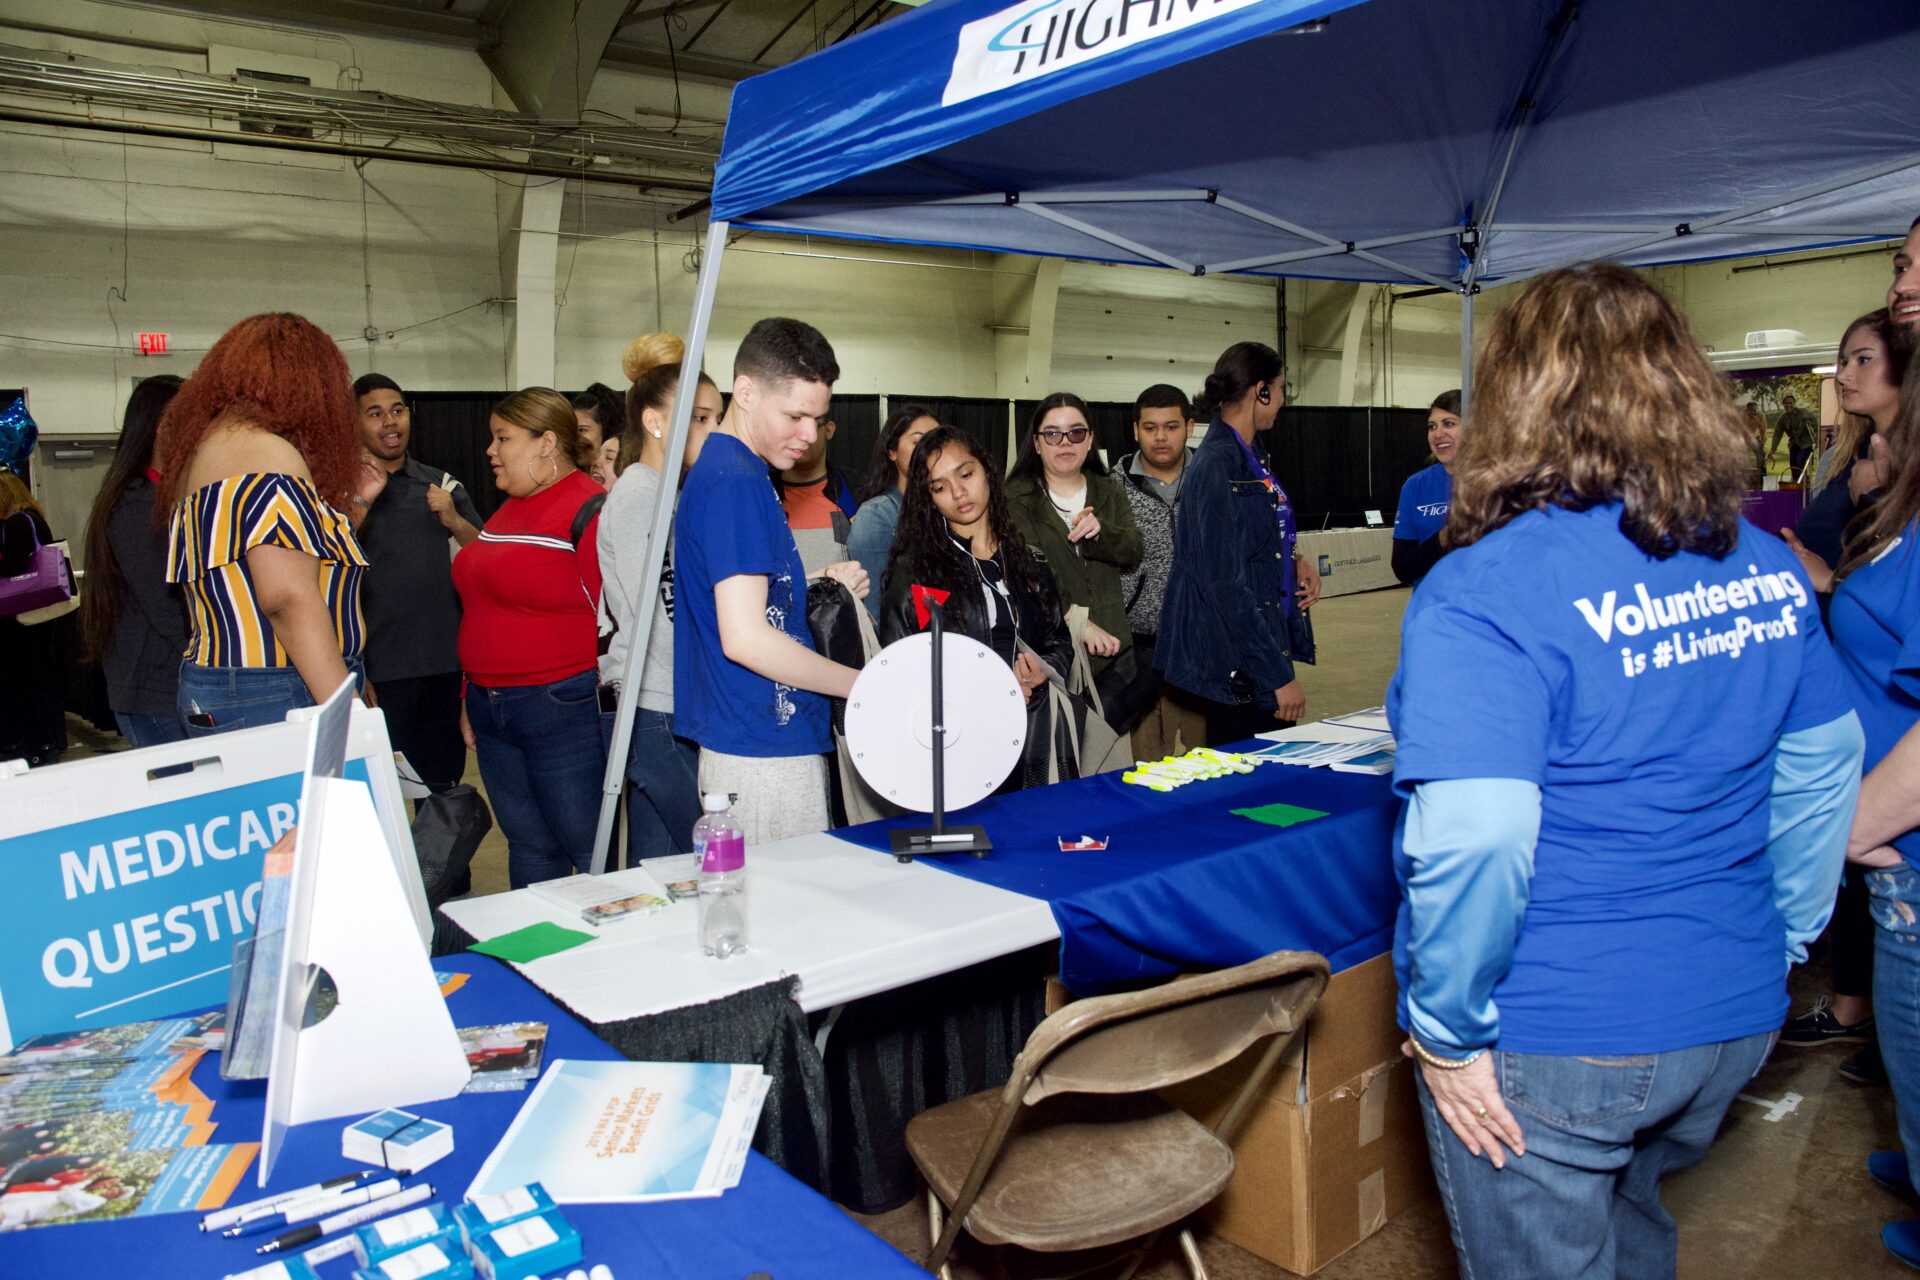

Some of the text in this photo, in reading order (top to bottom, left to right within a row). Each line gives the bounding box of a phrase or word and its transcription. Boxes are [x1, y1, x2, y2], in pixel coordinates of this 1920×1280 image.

[140, 333, 167, 353] EXIT
[1573, 563, 1808, 643] Volunteering
[1621, 604, 1798, 677] is #LivingProof
[60, 799, 302, 900] MEDICAR
